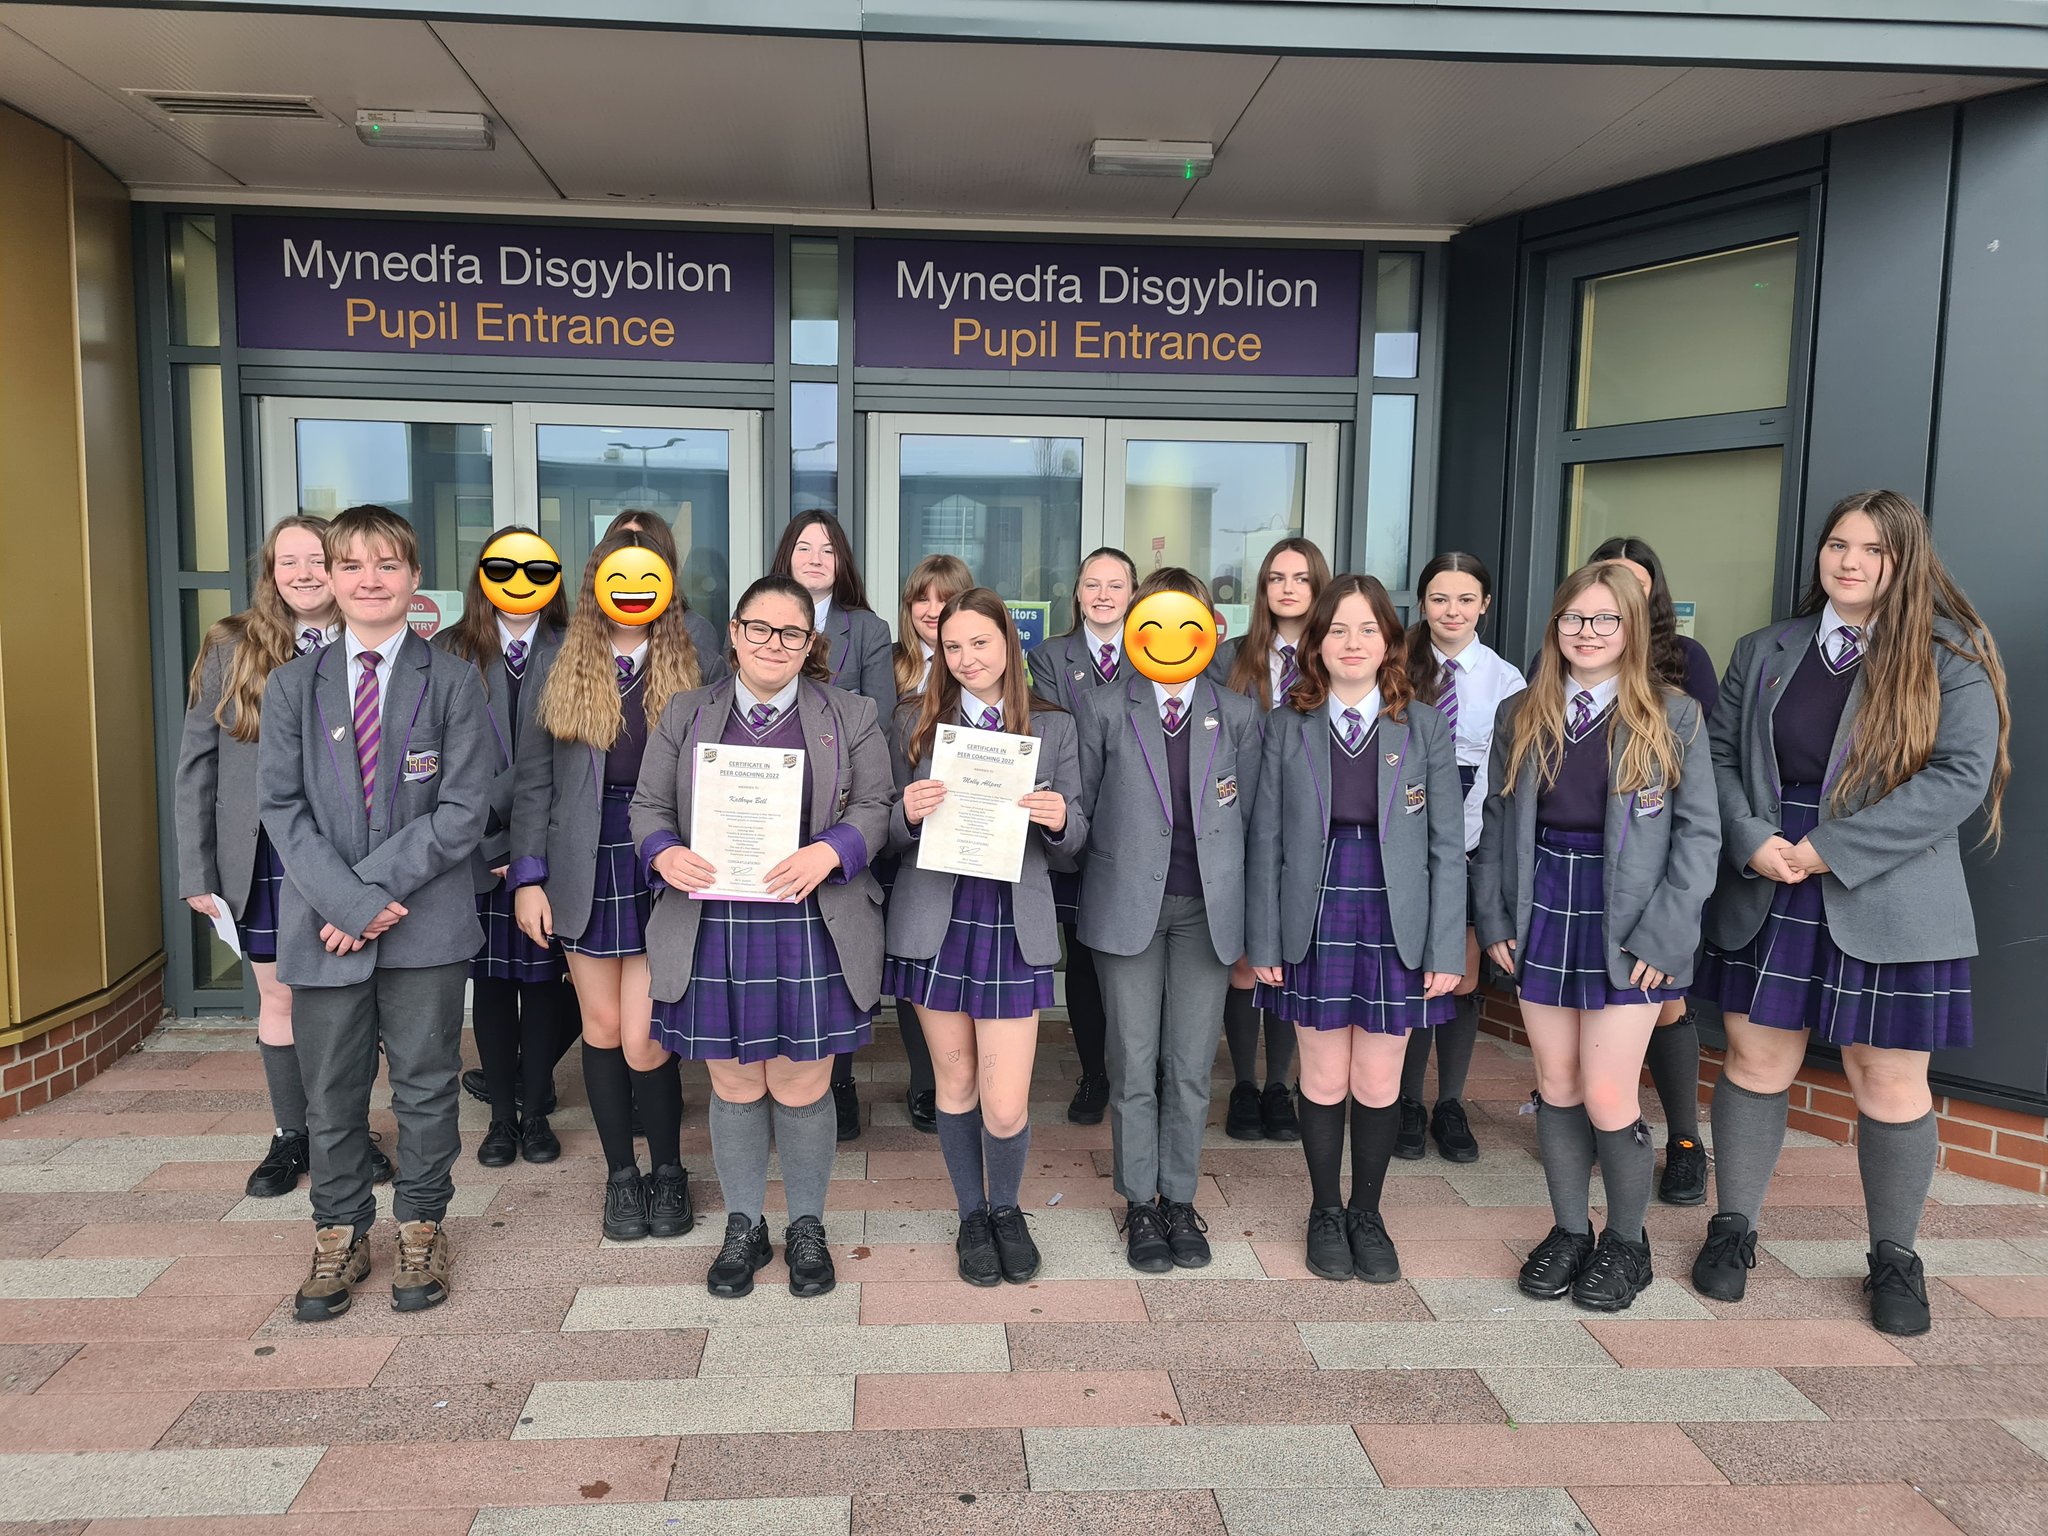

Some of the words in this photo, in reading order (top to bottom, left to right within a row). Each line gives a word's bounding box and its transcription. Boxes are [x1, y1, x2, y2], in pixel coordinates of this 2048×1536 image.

[282, 238, 483, 289] Mynedfa
[499, 246, 731, 298] Disgyblion
[897, 261, 1083, 310] Mynedfa
[1099, 266, 1318, 315] Disgyblion
[346, 298, 458, 348] Pupil
[476, 302, 675, 347] Entrance
[953, 318, 1057, 366] Pupil
[1075, 321, 1262, 361] Entrance
[410, 603, 425, 611] NO
[410, 622, 434, 631] NTRY
[1017, 629, 1031, 640] he
[967, 743, 999, 753] CERTIFICATE
[408, 757, 438, 773] RHS
[729, 761, 762, 769] CERTIFICATE
[957, 751, 971, 759] PEER
[972, 754, 1000, 762] COACHING
[1001, 757, 1015, 765] 2022
[1218, 782, 1237, 798] RHS
[1407, 790, 1425, 805] RHS
[1640, 792, 1664, 808] RHS
